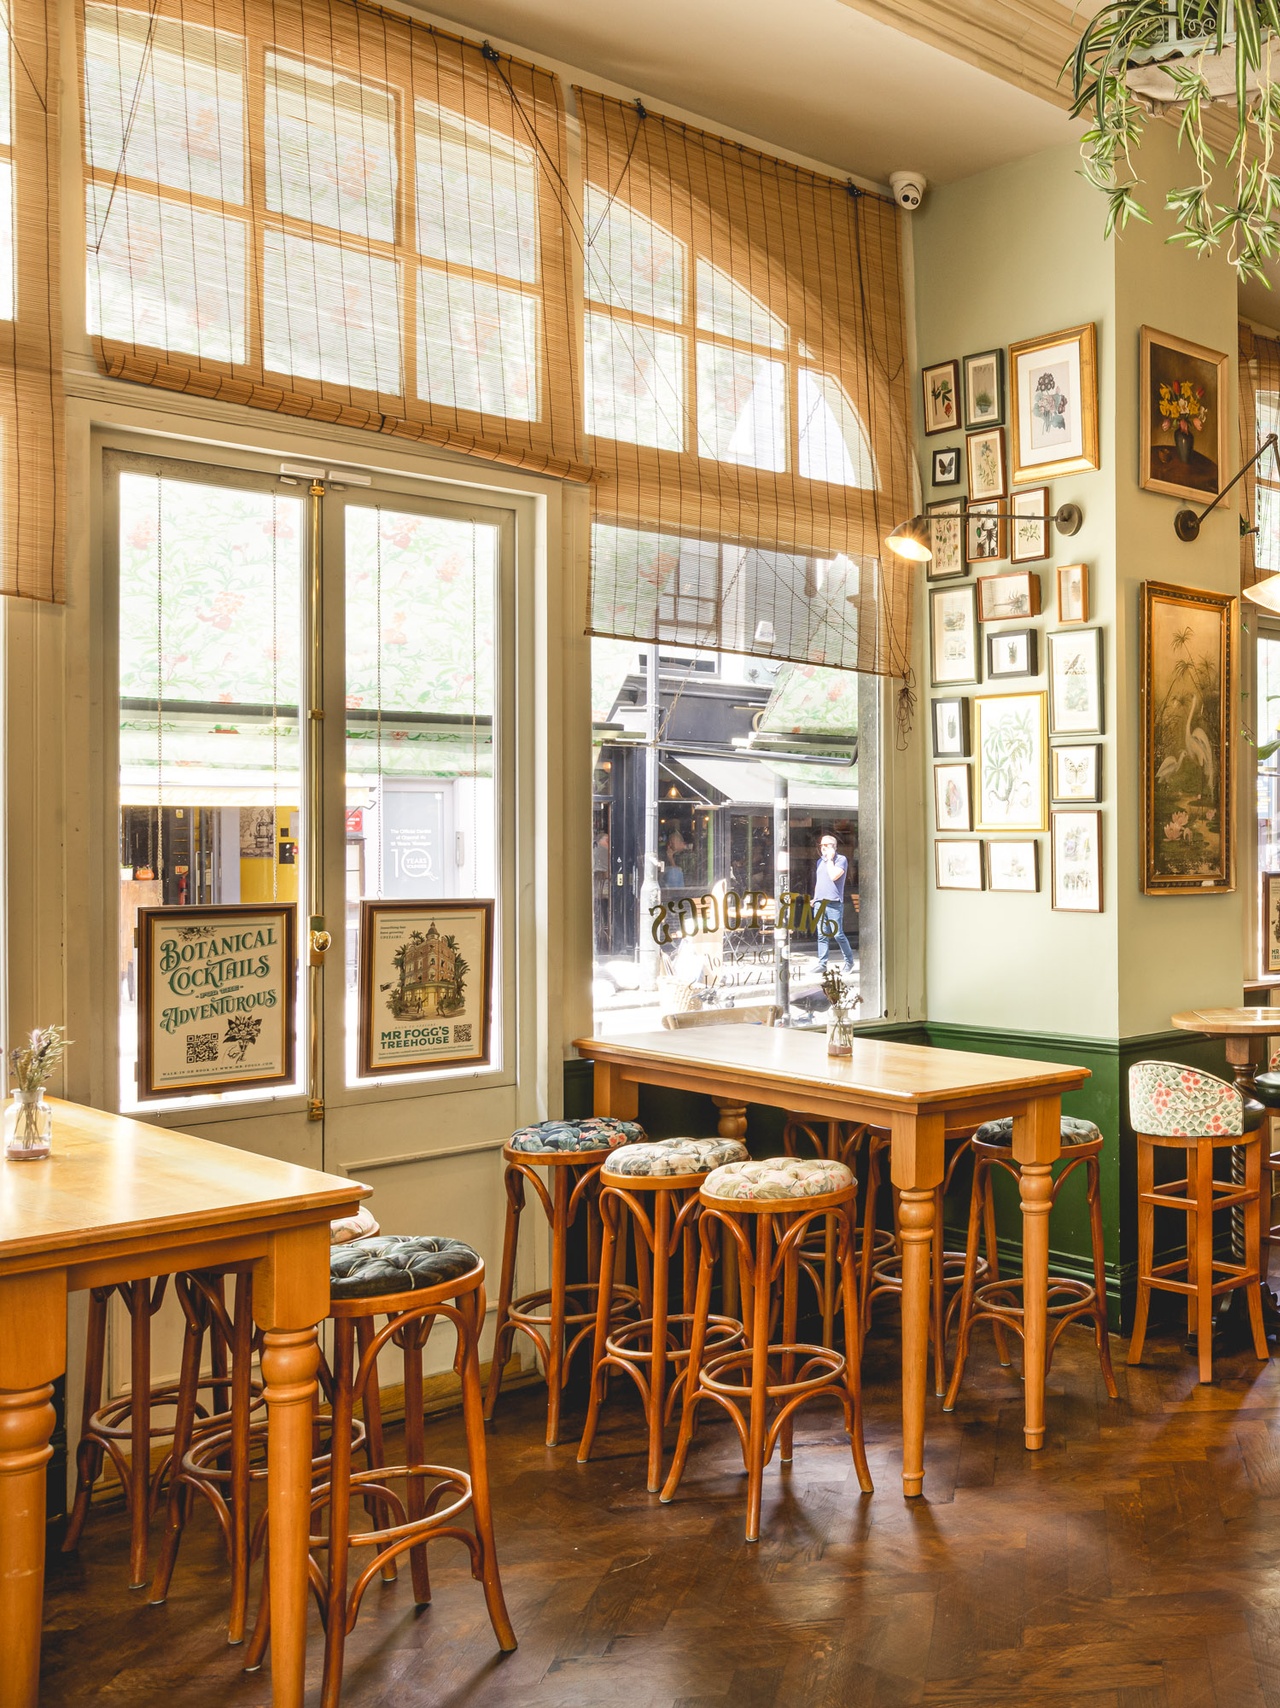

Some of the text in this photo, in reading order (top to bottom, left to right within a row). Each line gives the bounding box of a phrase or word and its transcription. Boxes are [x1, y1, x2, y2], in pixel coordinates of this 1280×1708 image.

[160, 928, 278, 975] BOTANICAL
[168, 955, 270, 996] COCKTAILS
[160, 989, 277, 1035] ADVENTUROUS
[380, 1036, 450, 1050] TREEHOUSE
[381, 1026, 450, 1041] MR FOGG'S
